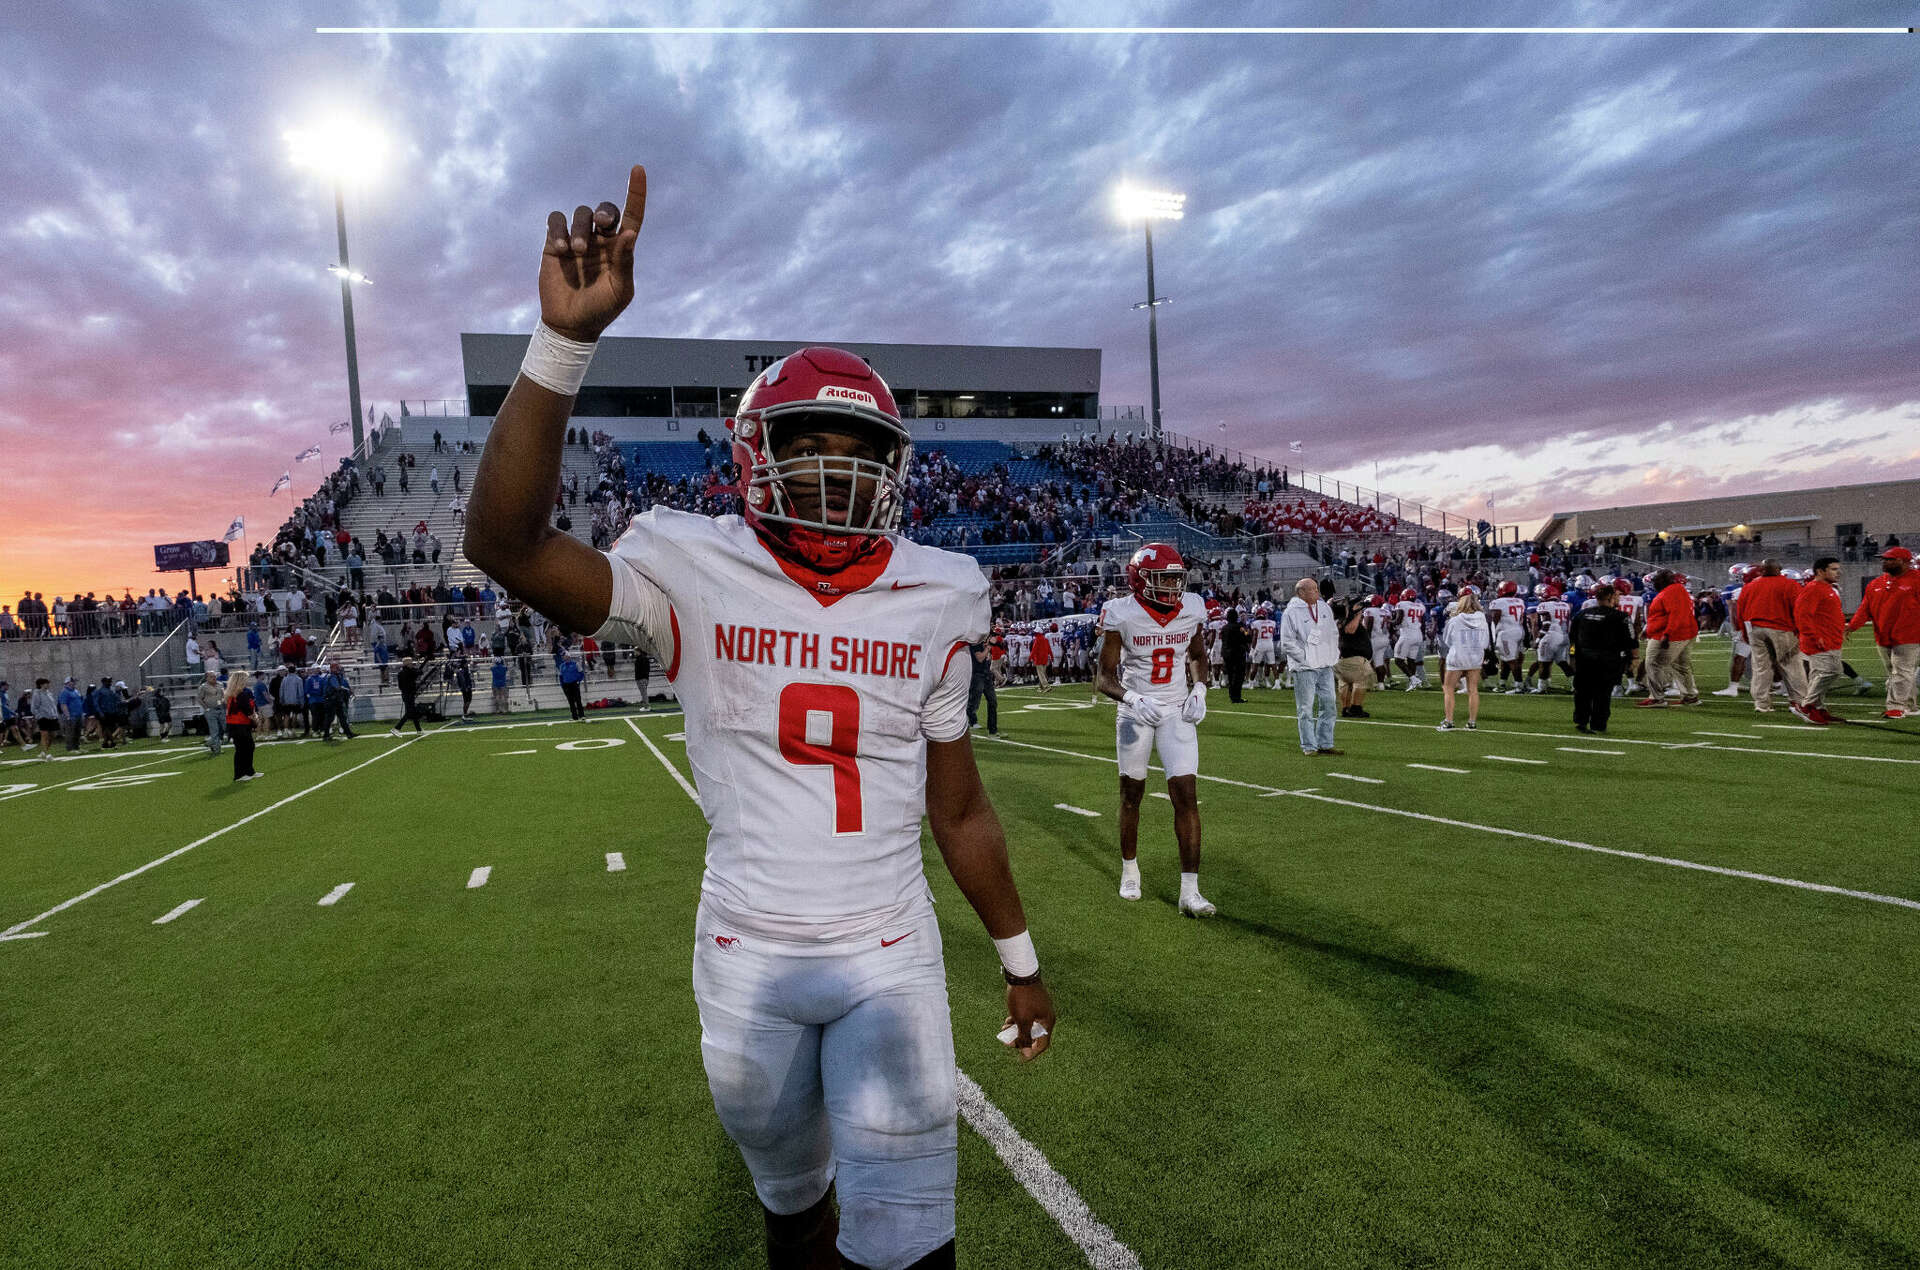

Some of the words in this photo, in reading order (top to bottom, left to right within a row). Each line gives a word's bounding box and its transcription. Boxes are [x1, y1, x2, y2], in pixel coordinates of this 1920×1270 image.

[826, 387, 872, 403] Riddell
[715, 623, 820, 668] NORTH
[830, 637, 922, 679] SHORE
[1133, 635, 1163, 646] NORTH
[1165, 632, 1190, 645] SHORE
[1151, 647, 1175, 684] 8
[778, 682, 865, 837] 9
